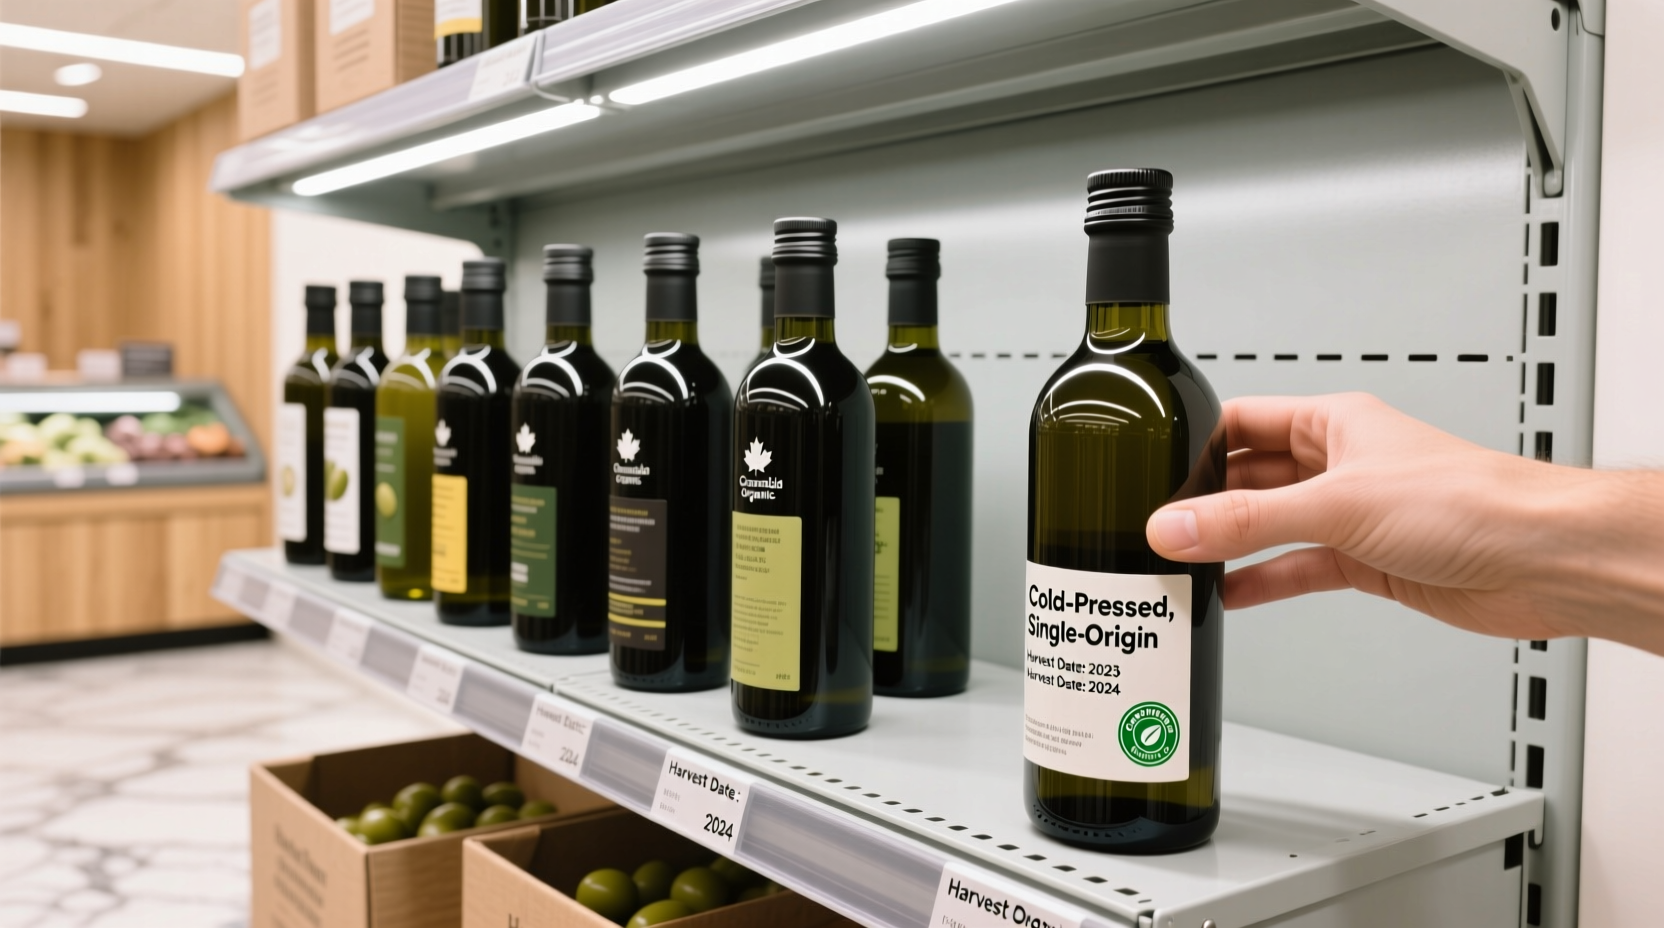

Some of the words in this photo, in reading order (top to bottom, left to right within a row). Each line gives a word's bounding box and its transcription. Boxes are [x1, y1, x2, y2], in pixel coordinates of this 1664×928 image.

[1029, 584, 1175, 623] Cold-Pressed,
[1028, 613, 1158, 654] Single-Origin
[1057, 656, 1086, 674] Date:
[1057, 675, 1086, 692] Date:
[1088, 680, 1121, 696] 2024
[669, 760, 708, 788] Harvest
[703, 813, 734, 842] 2024
[948, 878, 1010, 920] Harvest
